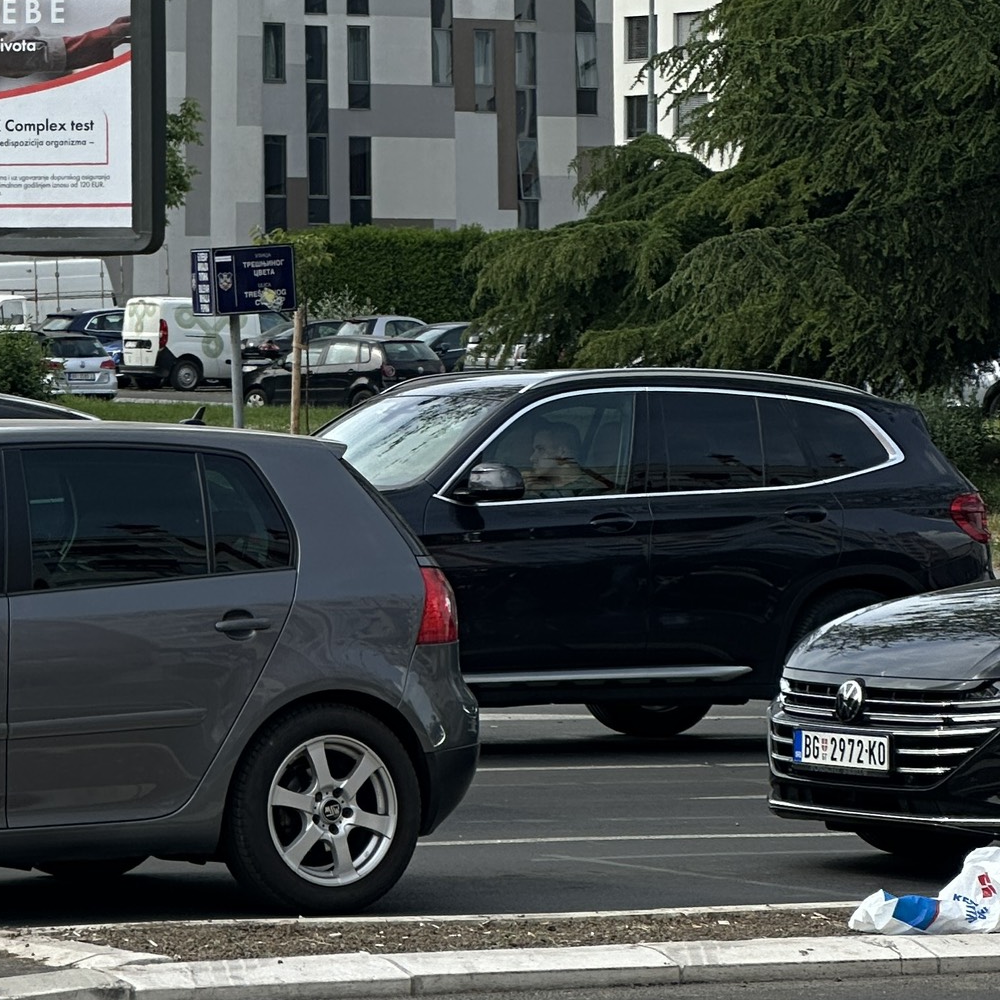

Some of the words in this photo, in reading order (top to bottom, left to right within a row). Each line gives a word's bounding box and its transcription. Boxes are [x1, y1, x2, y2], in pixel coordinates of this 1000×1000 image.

[5, 118, 67, 135] Complex
[70, 119, 94, 131] test
[46, 139, 87, 148] organizma
[253, 268, 275, 277] ЦВЕТА
[804, 734, 819, 759] BG
